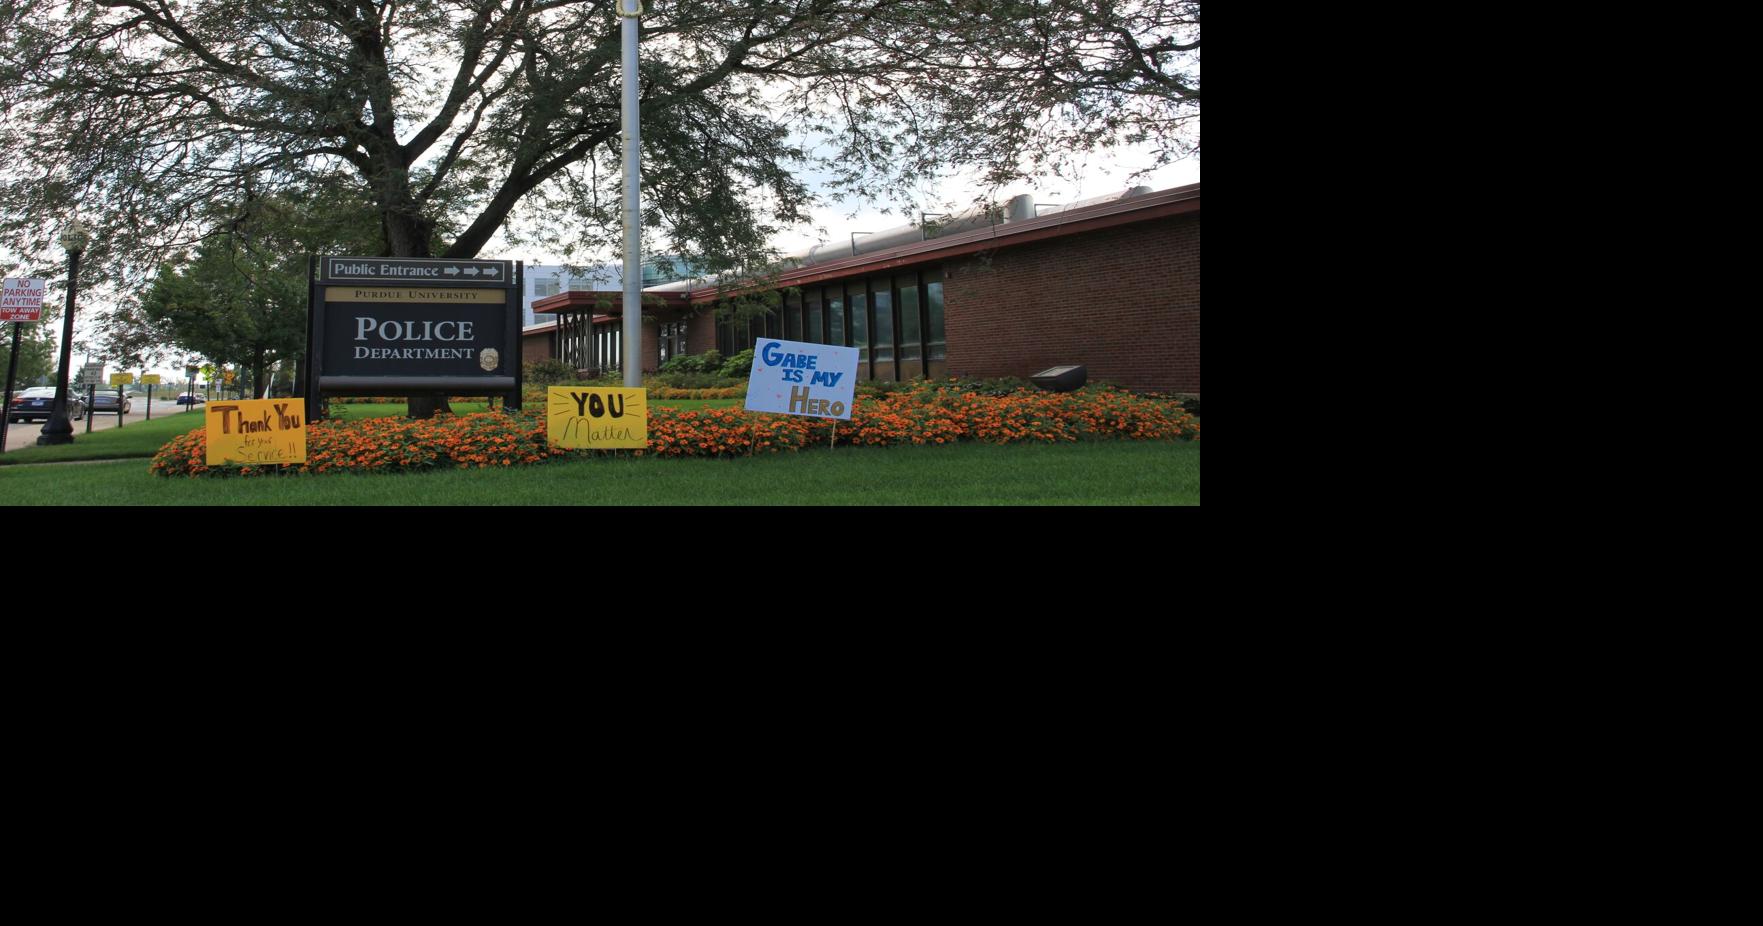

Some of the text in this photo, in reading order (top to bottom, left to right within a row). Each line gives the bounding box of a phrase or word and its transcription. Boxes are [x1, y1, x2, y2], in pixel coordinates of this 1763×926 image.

[334, 263, 439, 277] Public Entrance
[3, 288, 42, 297] PARKING
[17, 279, 31, 288] NO
[2, 297, 41, 306] ANYTIME
[355, 290, 479, 300] PURDUE UNIVERSITY
[354, 317, 475, 341] POLICE
[353, 346, 475, 359] DEPARTMENT
[762, 342, 818, 370] GABE
[781, 369, 844, 387] IS MY
[570, 391, 624, 418] YOU
[788, 385, 845, 416] HERO
[211, 405, 272, 434] Thank
[563, 416, 643, 444] Matter
